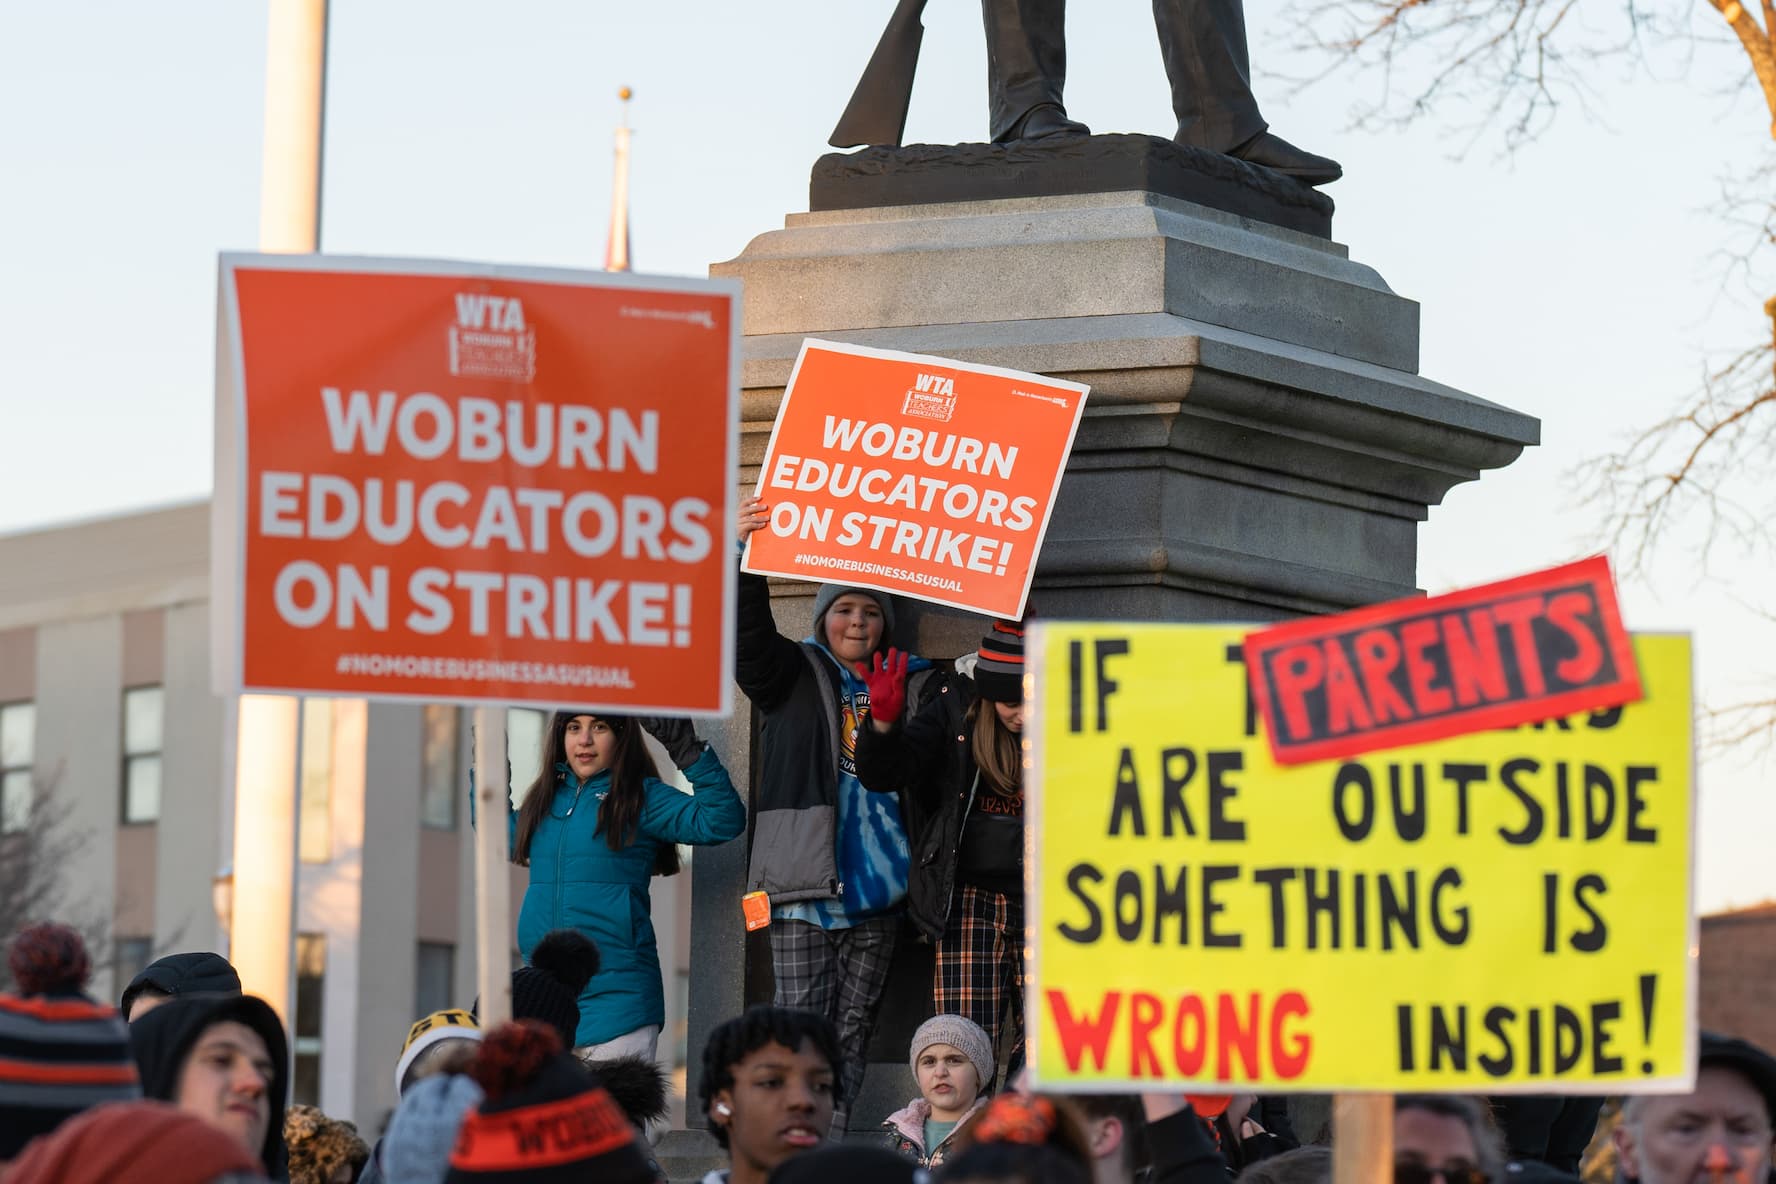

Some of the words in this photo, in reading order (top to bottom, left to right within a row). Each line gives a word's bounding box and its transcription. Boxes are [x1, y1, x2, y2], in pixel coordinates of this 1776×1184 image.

[455, 293, 526, 333] WTA
[914, 393, 944, 404] WOBURN
[915, 373, 955, 397] WTA
[321, 387, 658, 474] WOBURN
[823, 415, 1018, 480] WOBURN
[259, 470, 711, 563] EDUCATORS
[771, 455, 1037, 532] EDUCATORS
[770, 501, 833, 542] ON
[836, 512, 1013, 577] STRIKE!
[795, 554, 963, 592] #NOMOREBUSINESSASUSUAL
[273, 560, 389, 631] ON
[405, 567, 692, 648] STRIKE!
[336, 655, 635, 688] #NOMOREBUSINESSASUSUAL
[1067, 639, 1129, 733] IF
[1269, 593, 1604, 741] PARENTS
[1107, 747, 1247, 841] ARE
[1334, 757, 1658, 845] OUTSIDE
[1056, 862, 1470, 950] SOMETHING
[1543, 872, 1610, 954] IS
[1045, 989, 1312, 1081] WRONG
[1397, 973, 1658, 1077] INSIDE!
